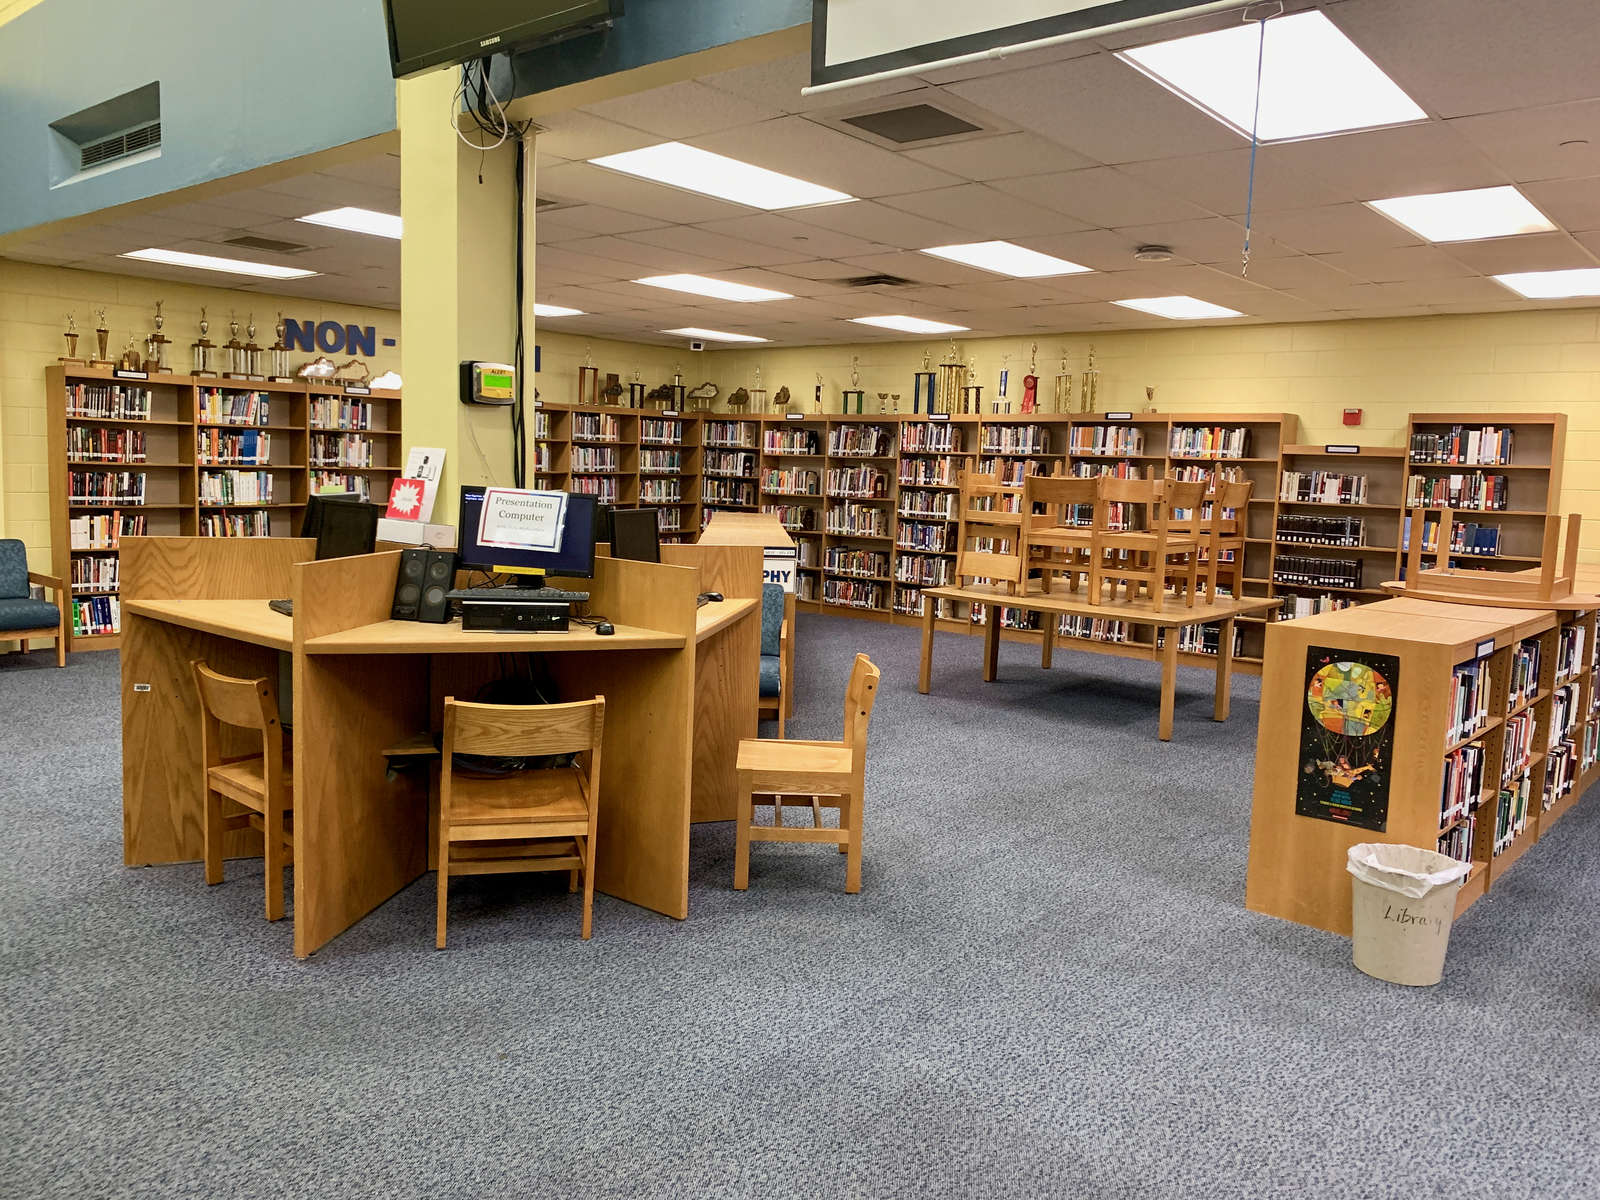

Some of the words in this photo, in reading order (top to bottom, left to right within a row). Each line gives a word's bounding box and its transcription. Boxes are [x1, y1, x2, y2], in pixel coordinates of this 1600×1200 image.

[495, 496, 553, 510] Presentation
[498, 510, 544, 522] Computer
[763, 570, 791, 583] PHY
